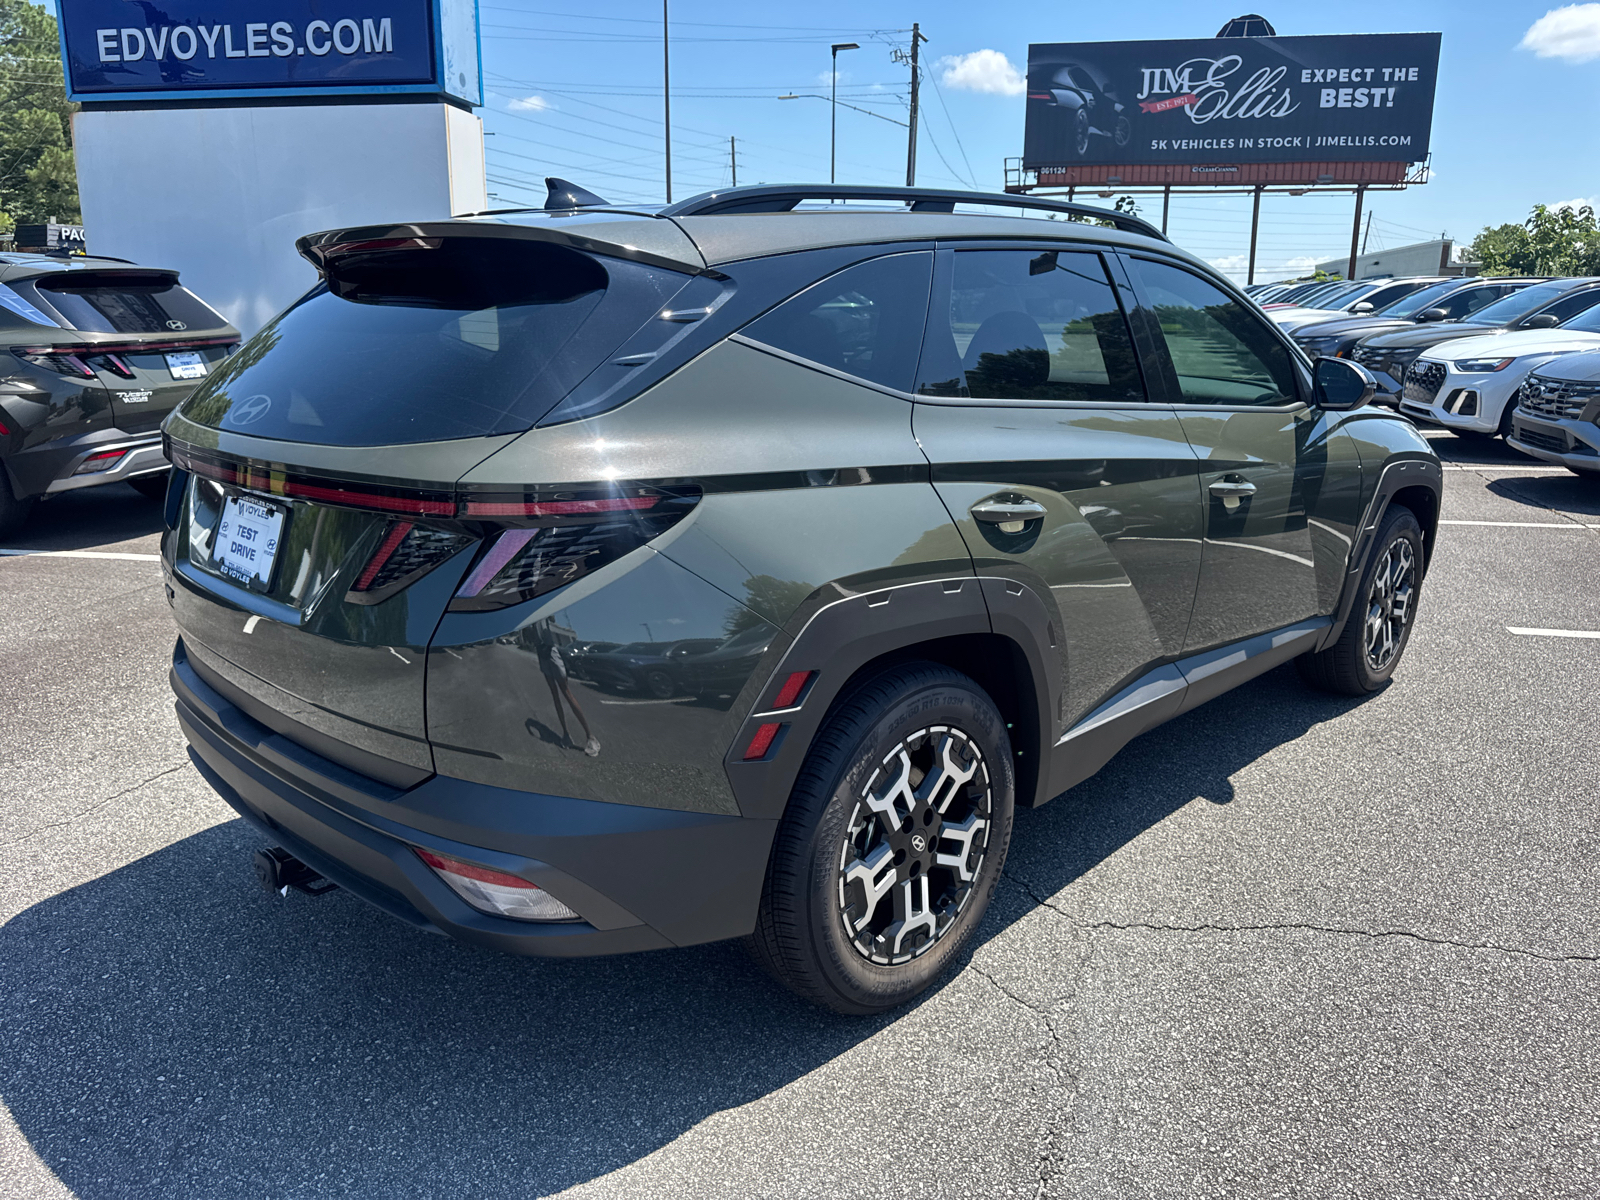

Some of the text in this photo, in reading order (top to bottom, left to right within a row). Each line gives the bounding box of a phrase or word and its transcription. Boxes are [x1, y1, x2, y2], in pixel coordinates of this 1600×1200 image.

[97, 17, 393, 63] EDVOYLES.COM
[1301, 67, 1419, 83] EXPECT THE
[1137, 55, 1301, 124] JIM Ellis
[1319, 87, 1396, 108] BEST!
[1156, 101, 1173, 111] EST.
[1151, 139, 1168, 150] 5K
[1172, 138, 1235, 149] VEHICLES
[1239, 138, 1254, 148] IN
[1257, 136, 1302, 148] STOCK
[1315, 135, 1412, 147] JIMELLIS.COM
[236, 524, 259, 542] TEST
[230, 541, 257, 562] DRIVE
[228, 568, 251, 584] VOYLES
